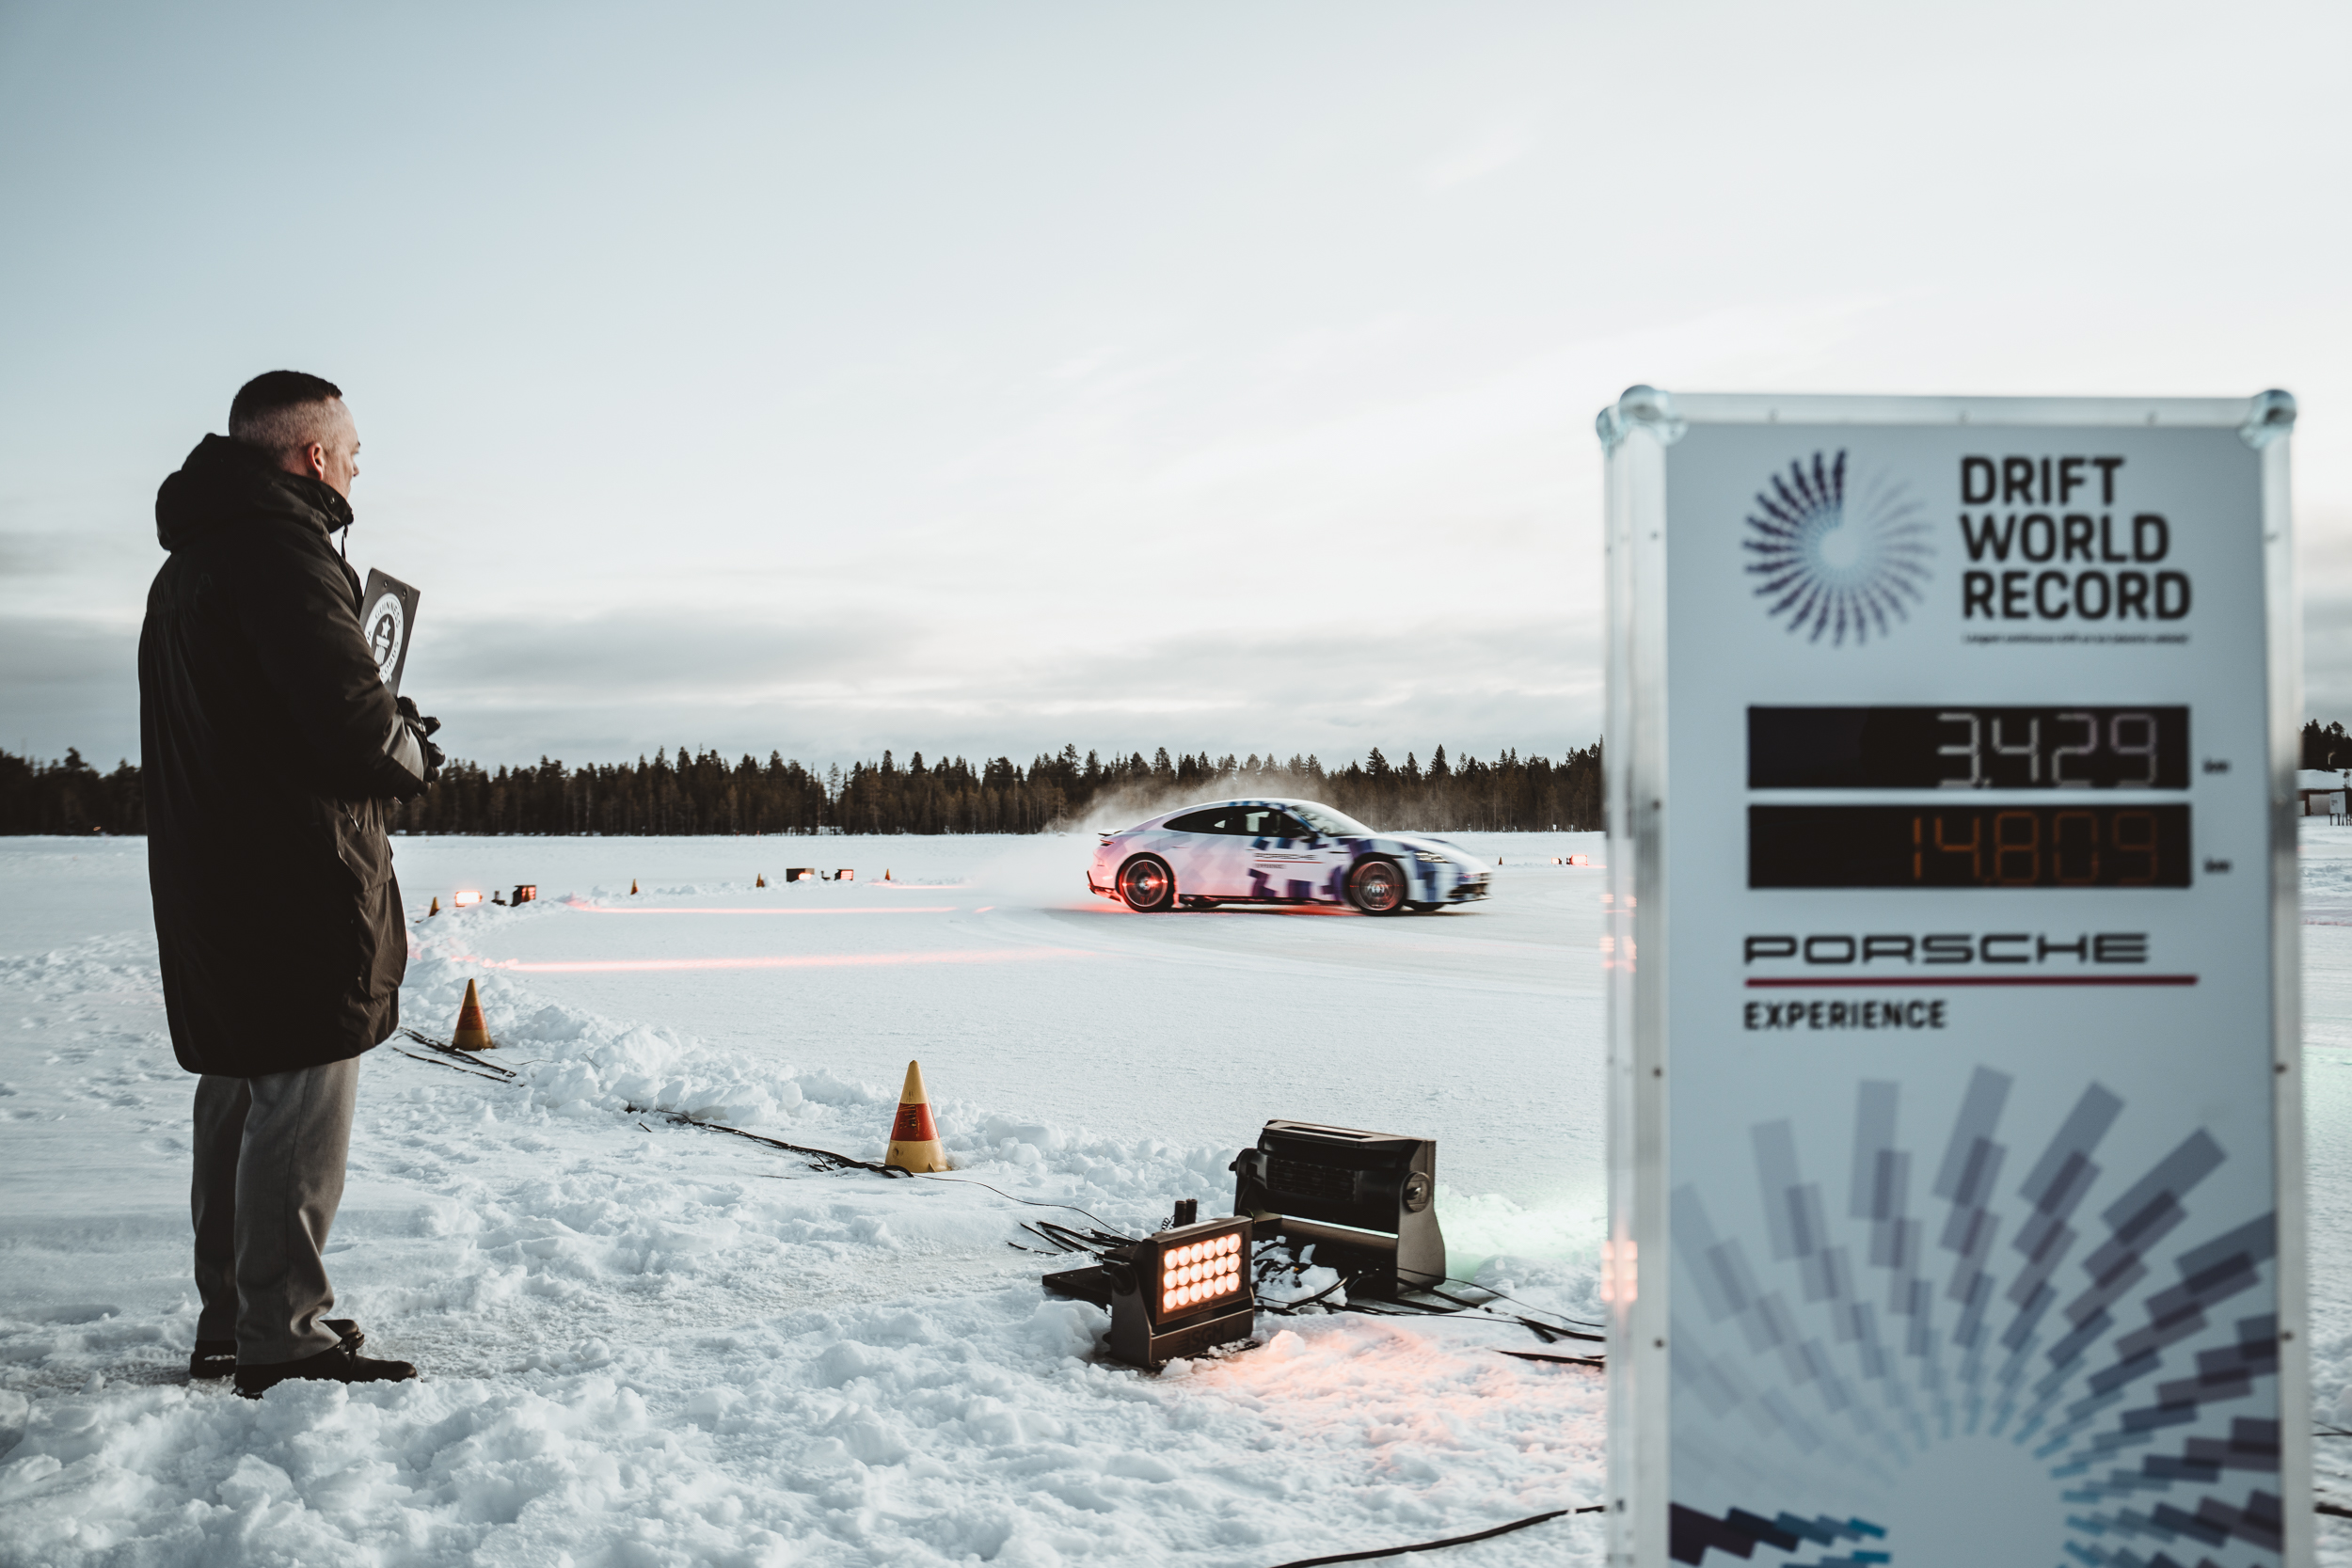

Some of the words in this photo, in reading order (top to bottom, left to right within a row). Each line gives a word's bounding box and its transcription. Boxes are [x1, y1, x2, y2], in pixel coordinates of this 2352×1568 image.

[1961, 455, 2125, 506] DRIFT
[1960, 513, 2170, 564] WORLD
[1963, 569, 2193, 621] RECORD
[374, 601, 401, 628] GUINNESS
[380, 641, 399, 678] CORDS
[1744, 932, 2148, 965] PORSCHE
[1744, 1000, 1946, 1030] EXPERIENCE
[1191, 1323, 1225, 1347] SGM
